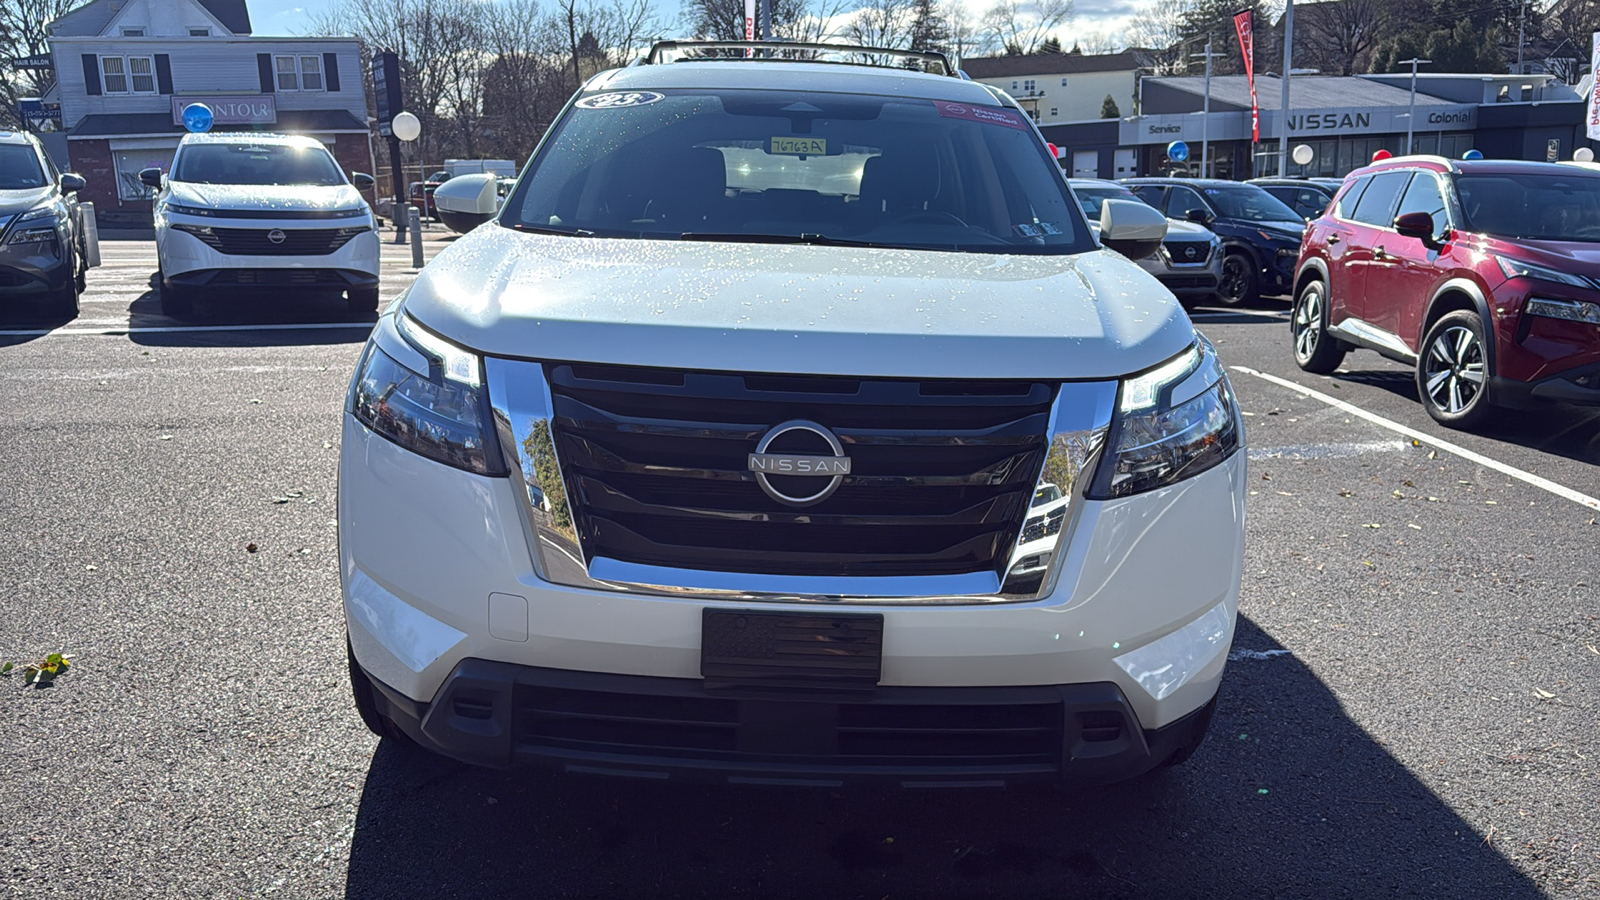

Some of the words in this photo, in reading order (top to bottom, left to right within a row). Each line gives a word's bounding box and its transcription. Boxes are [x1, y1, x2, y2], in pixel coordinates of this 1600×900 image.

[972, 108, 1006, 119] Nissan
[975, 113, 1018, 125] Certified
[1428, 111, 1470, 124] Colonial
[1287, 112, 1370, 131] NISSAN
[1149, 124, 1181, 134] Service
[751, 456, 848, 473] NISSAN
